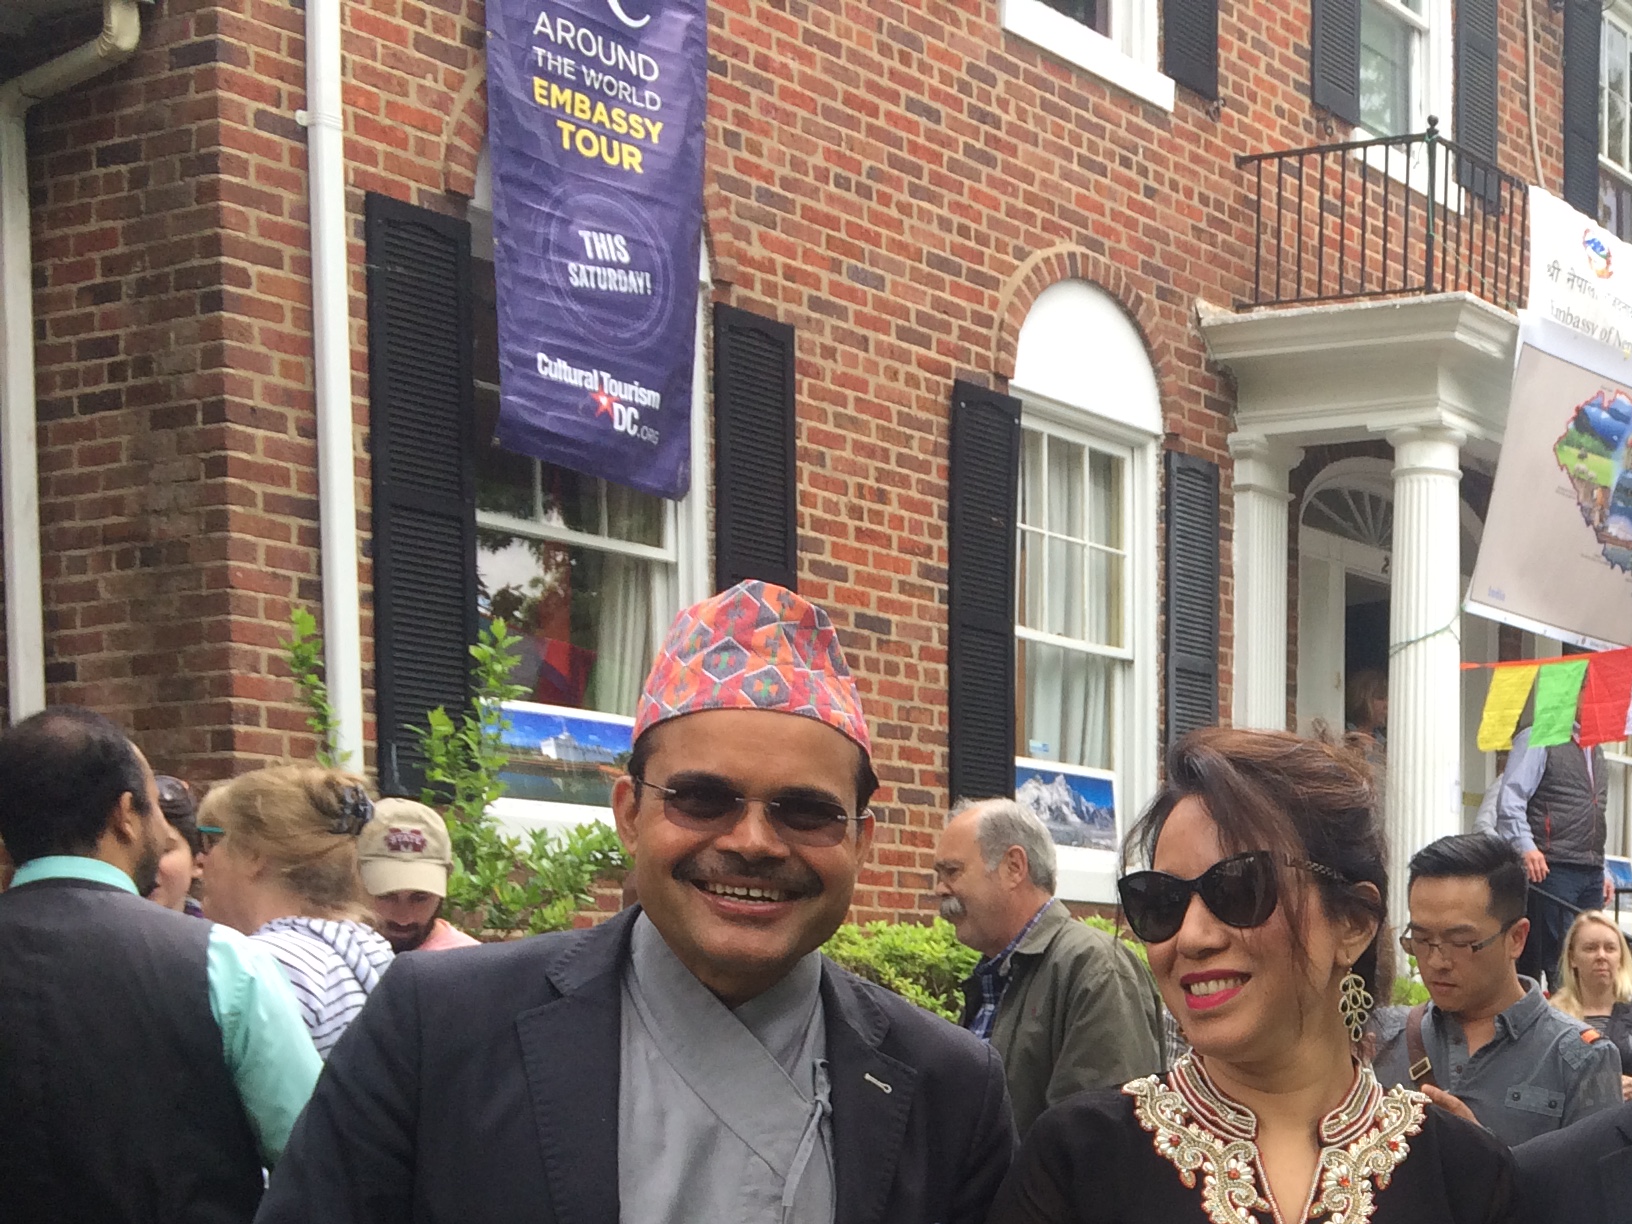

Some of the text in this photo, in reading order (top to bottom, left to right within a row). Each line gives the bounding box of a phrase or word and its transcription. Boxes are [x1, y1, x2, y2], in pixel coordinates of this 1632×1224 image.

[532, 11, 660, 82] AROUND
[532, 46, 662, 112] THE WORLD
[532, 76, 664, 144] EMBASSY
[556, 120, 644, 174] TOUR
[578, 229, 631, 265] THIS
[567, 263, 653, 296] SATURDAY!
[1550, 299, 1599, 337] Embassy
[1600, 327, 1615, 344] of
[536, 351, 661, 410] Cultural Tourism
[387, 831, 424, 846] STATE
